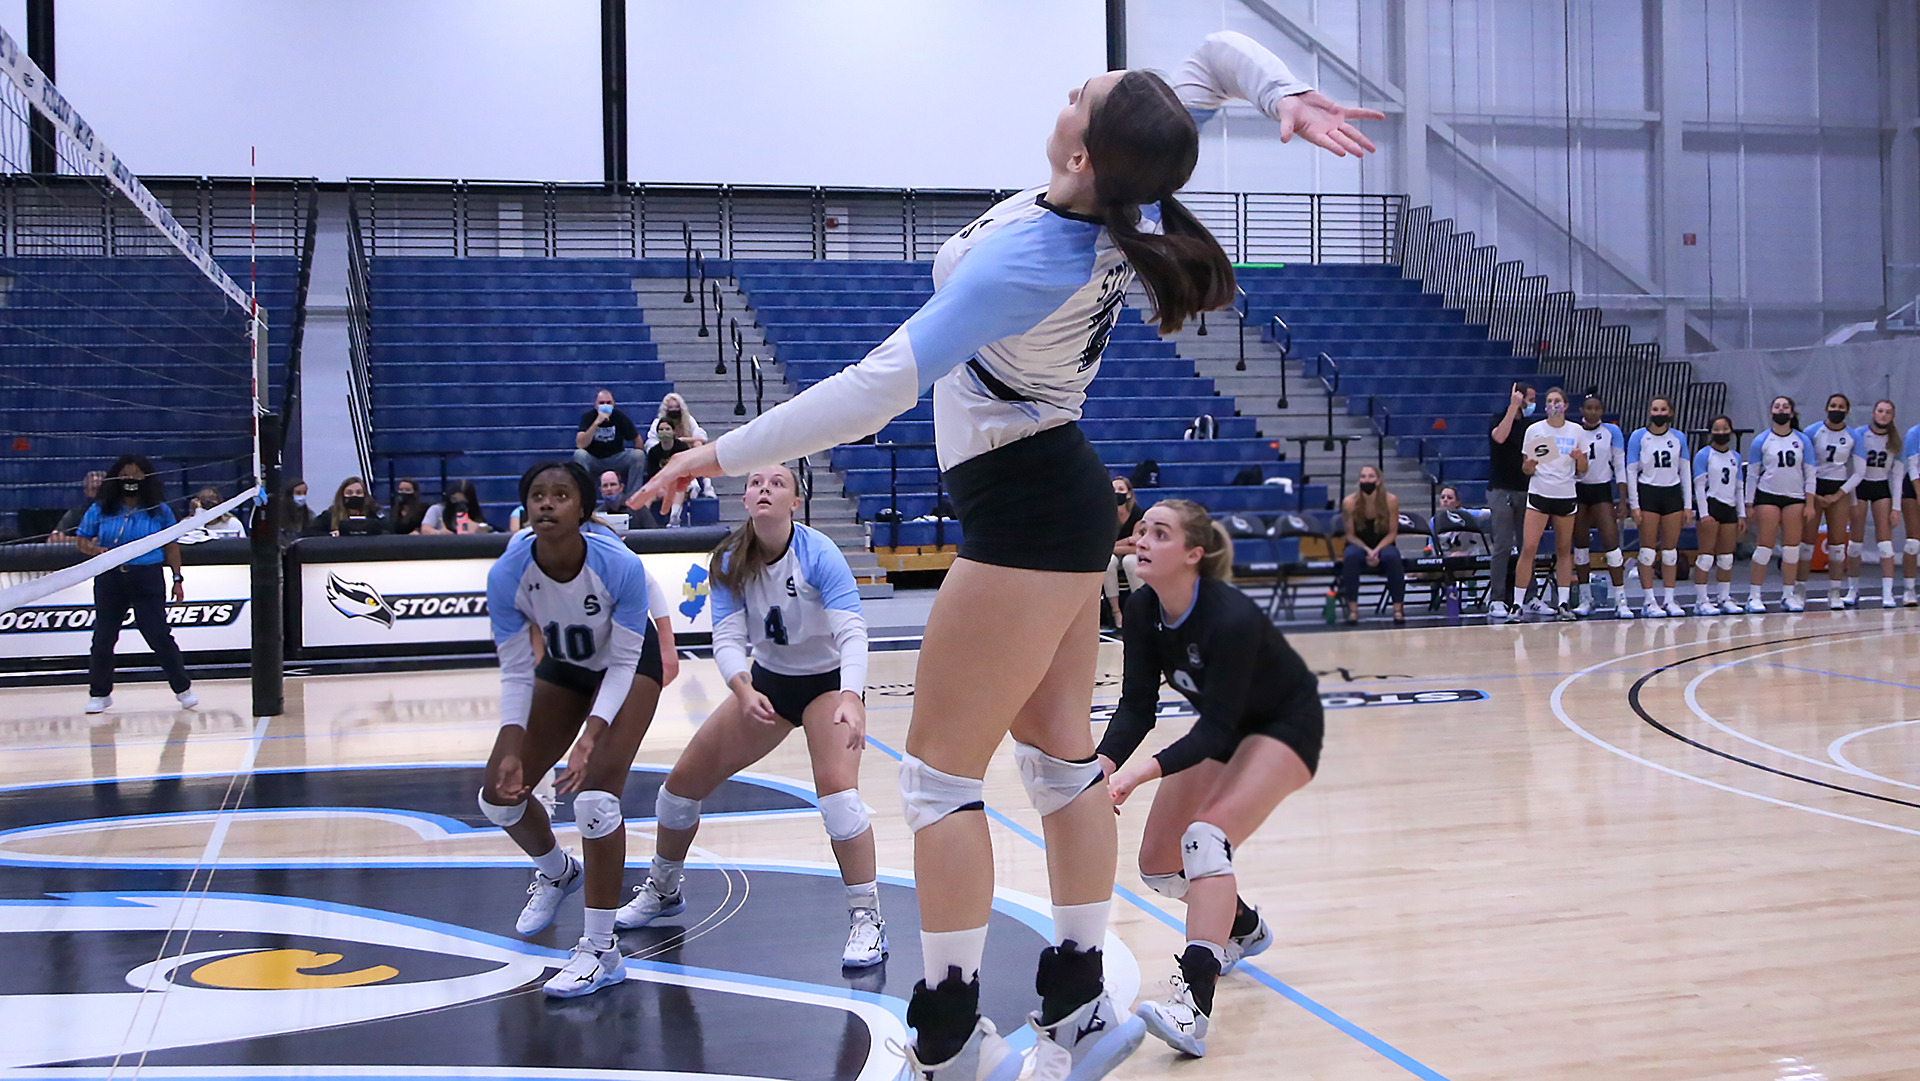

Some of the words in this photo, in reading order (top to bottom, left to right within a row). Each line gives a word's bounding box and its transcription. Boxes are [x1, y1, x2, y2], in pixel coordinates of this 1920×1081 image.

[1653, 450, 1672, 468] 12
[1777, 450, 1796, 468] 16
[1825, 445, 1837, 462] 7
[1866, 450, 1888, 468] 22
[1721, 467, 1731, 485] 3
[393, 597, 489, 616] STOCKT
[583, 594, 602, 616] S
[764, 605, 789, 645] 4
[543, 620, 596, 662] 10
